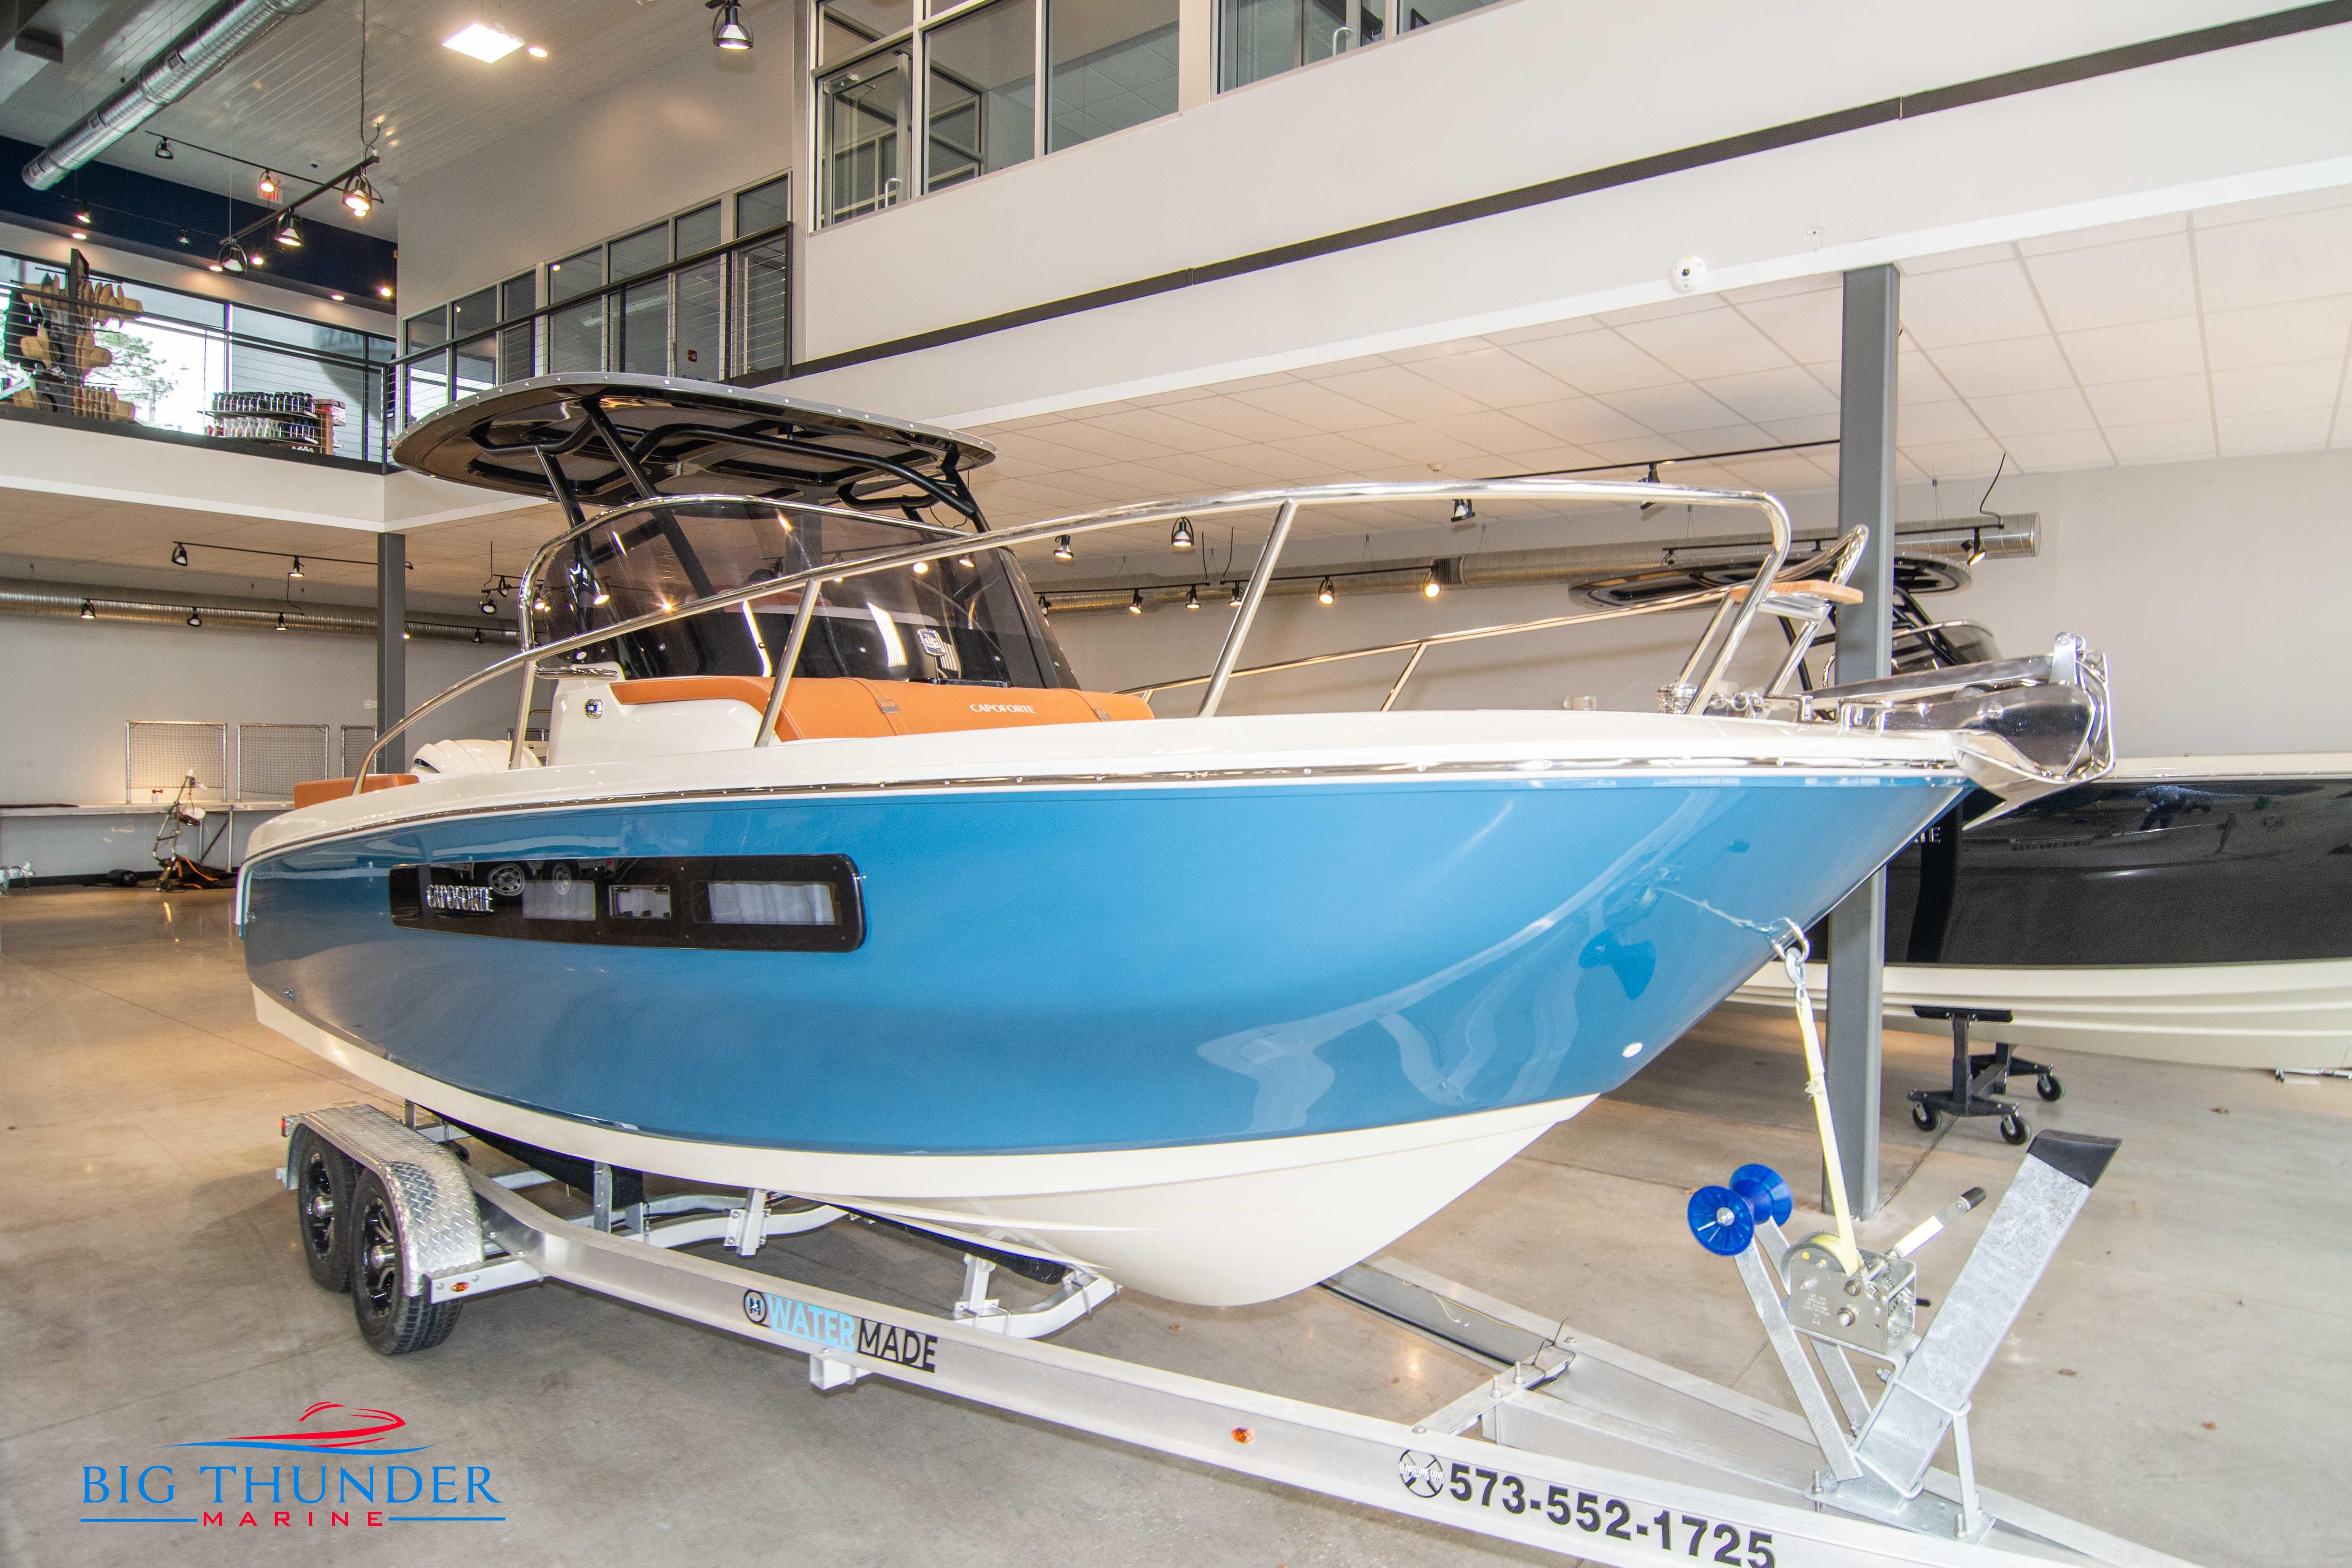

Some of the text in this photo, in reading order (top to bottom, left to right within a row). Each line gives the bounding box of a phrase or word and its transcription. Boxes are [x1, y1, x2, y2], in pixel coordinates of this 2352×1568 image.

[970, 704, 1037, 714] CAPOFORTE
[766, 1294, 938, 1373] WATER MADE
[1399, 1462, 1445, 1479] GLADSTONE COVE
[1450, 1462, 1775, 1568] 573-552-1725
